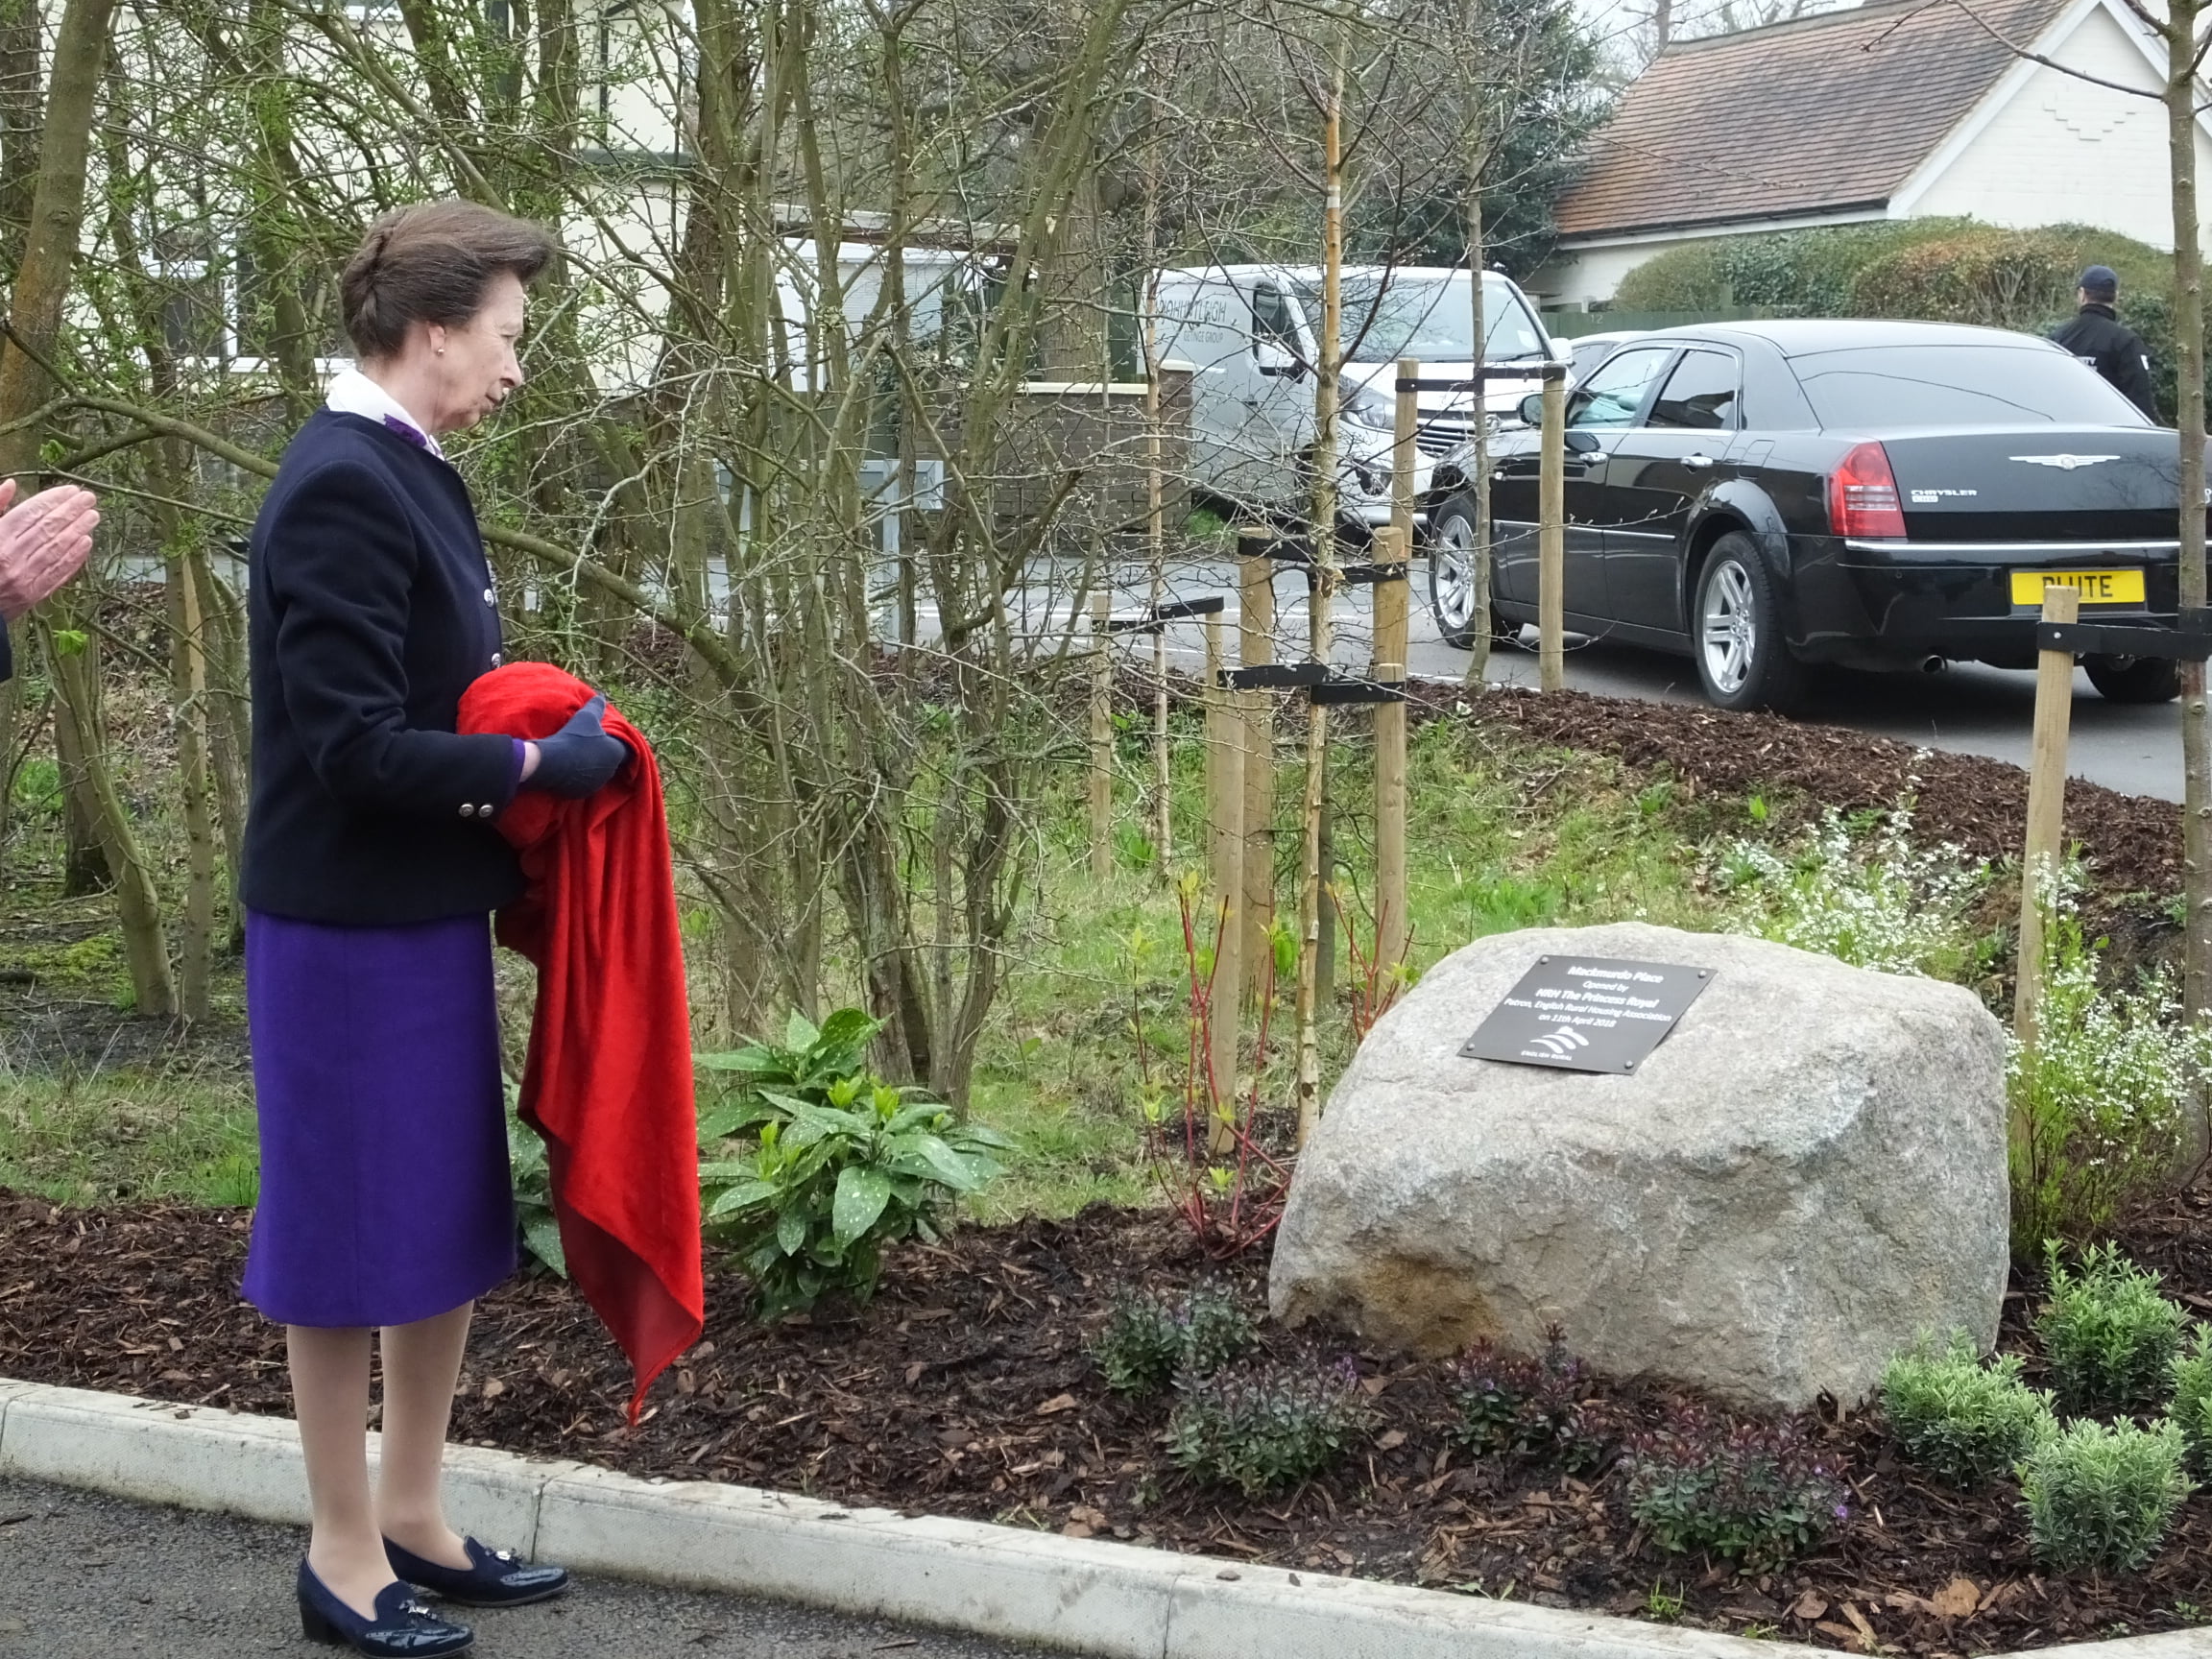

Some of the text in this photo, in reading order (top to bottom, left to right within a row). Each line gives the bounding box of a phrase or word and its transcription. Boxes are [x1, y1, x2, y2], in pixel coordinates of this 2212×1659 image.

[1205, 331, 1224, 344] GROUP
[1633, 972, 1664, 983] Place
[1582, 980, 1629, 993] Opened by
[1535, 988, 1660, 1009] HRH The Princess Royal
[1534, 1000, 1564, 1011] English
[1565, 1003, 1588, 1013] Rural
[1588, 1006, 1623, 1018] Housing
[1623, 1009, 1672, 1022] Association
[1551, 1014, 1572, 1023] 11th
[1572, 1016, 1593, 1025] April
[1593, 1018, 1617, 1028] 2018
